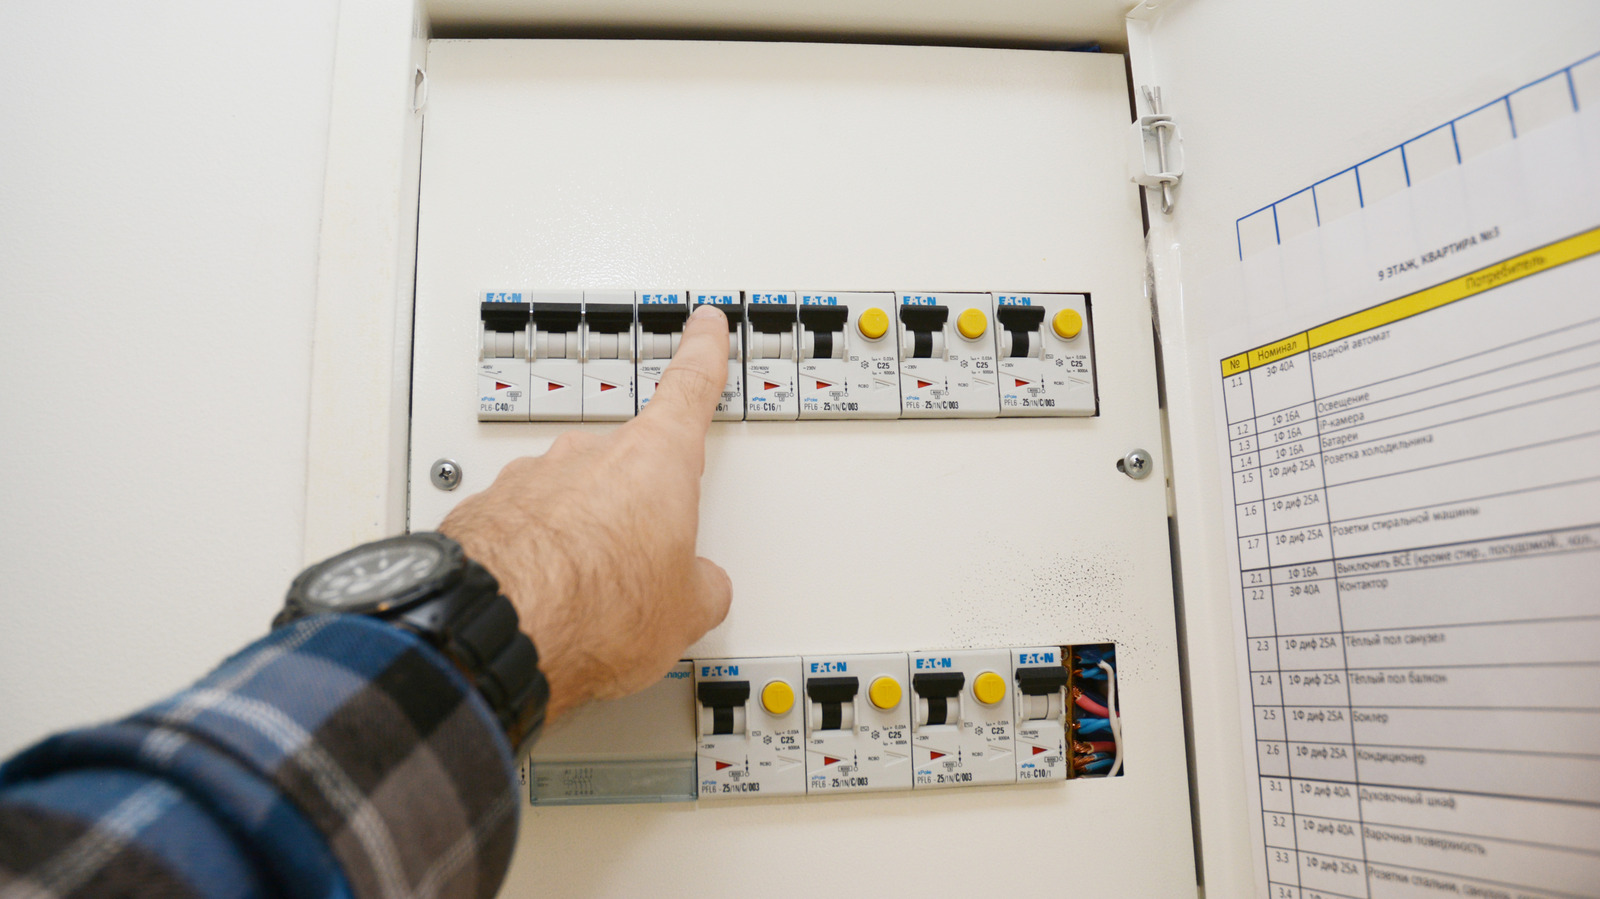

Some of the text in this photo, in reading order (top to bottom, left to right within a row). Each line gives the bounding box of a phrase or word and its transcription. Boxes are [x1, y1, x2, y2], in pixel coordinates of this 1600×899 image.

[1378, 270, 1385, 281] 9
[1421, 235, 1478, 266] КВАРТИРА
[486, 293, 522, 303] EATON
[642, 294, 678, 304] EATON
[698, 295, 733, 304] EATON
[752, 294, 788, 304] EATON
[803, 296, 837, 306] EATON
[903, 296, 937, 306] EATON
[998, 296, 1031, 306] EATON
[1312, 330, 1391, 362] Вводной автомат
[1230, 340, 1298, 370] № Номинал
[877, 362, 890, 370] C25
[976, 361, 989, 369] C25
[1070, 360, 1083, 368] C25
[1266, 364, 1278, 378] 3Ф
[1231, 377, 1243, 388] 1.1
[1318, 392, 1370, 413] Освещение
[1272, 410, 1300, 426] 1Ф 16А
[1237, 424, 1249, 435] 1.2
[1274, 427, 1302, 442] 1Ф 16А
[1239, 440, 1250, 451] 1.3
[1322, 432, 1359, 448] Батареи
[1276, 443, 1304, 459] 1Ф 16А
[1324, 433, 1434, 465] Розетка холодильника
[1241, 456, 1252, 468] 1.4
[1269, 467, 1280, 478] 1Ф
[1281, 463, 1298, 477] диф
[1242, 473, 1253, 484] 1.5
[1272, 500, 1283, 512] 1Ф
[1285, 497, 1301, 510] диф
[1245, 505, 1257, 516] 1.6
[1332, 521, 1370, 537] Розетки
[1372, 510, 1430, 531] стиральной
[1275, 535, 1287, 546] 1Ф
[1289, 531, 1305, 545] диф
[1247, 539, 1259, 550] 1.7
[1337, 558, 1391, 574] Выключить
[1250, 574, 1263, 584] 2.1
[1288, 569, 1300, 580] 1Ф
[1339, 578, 1389, 592] Контактор
[1252, 590, 1264, 600] 2.2
[1290, 586, 1301, 597] 3Ф
[1285, 640, 1297, 650] 1Ф
[1299, 638, 1317, 651] диф
[1383, 634, 1402, 646] пол
[1404, 632, 1446, 648] санузел
[1257, 641, 1269, 651] 2.3
[916, 658, 952, 669] EATON
[1019, 653, 1054, 664] EATON
[702, 665, 739, 677] EATON
[811, 662, 847, 673] EATON
[1260, 675, 1273, 686] 2.4
[1387, 673, 1407, 685] пол
[1263, 709, 1276, 720] 2.5
[888, 731, 902, 739] C25
[991, 727, 1005, 735] C25
[780, 736, 795, 744] C25
[1266, 744, 1279, 755] 2.6
[1356, 749, 1426, 765] Кондиционер
[1270, 781, 1283, 792] 3.1
[1426, 796, 1456, 810] шкаф
